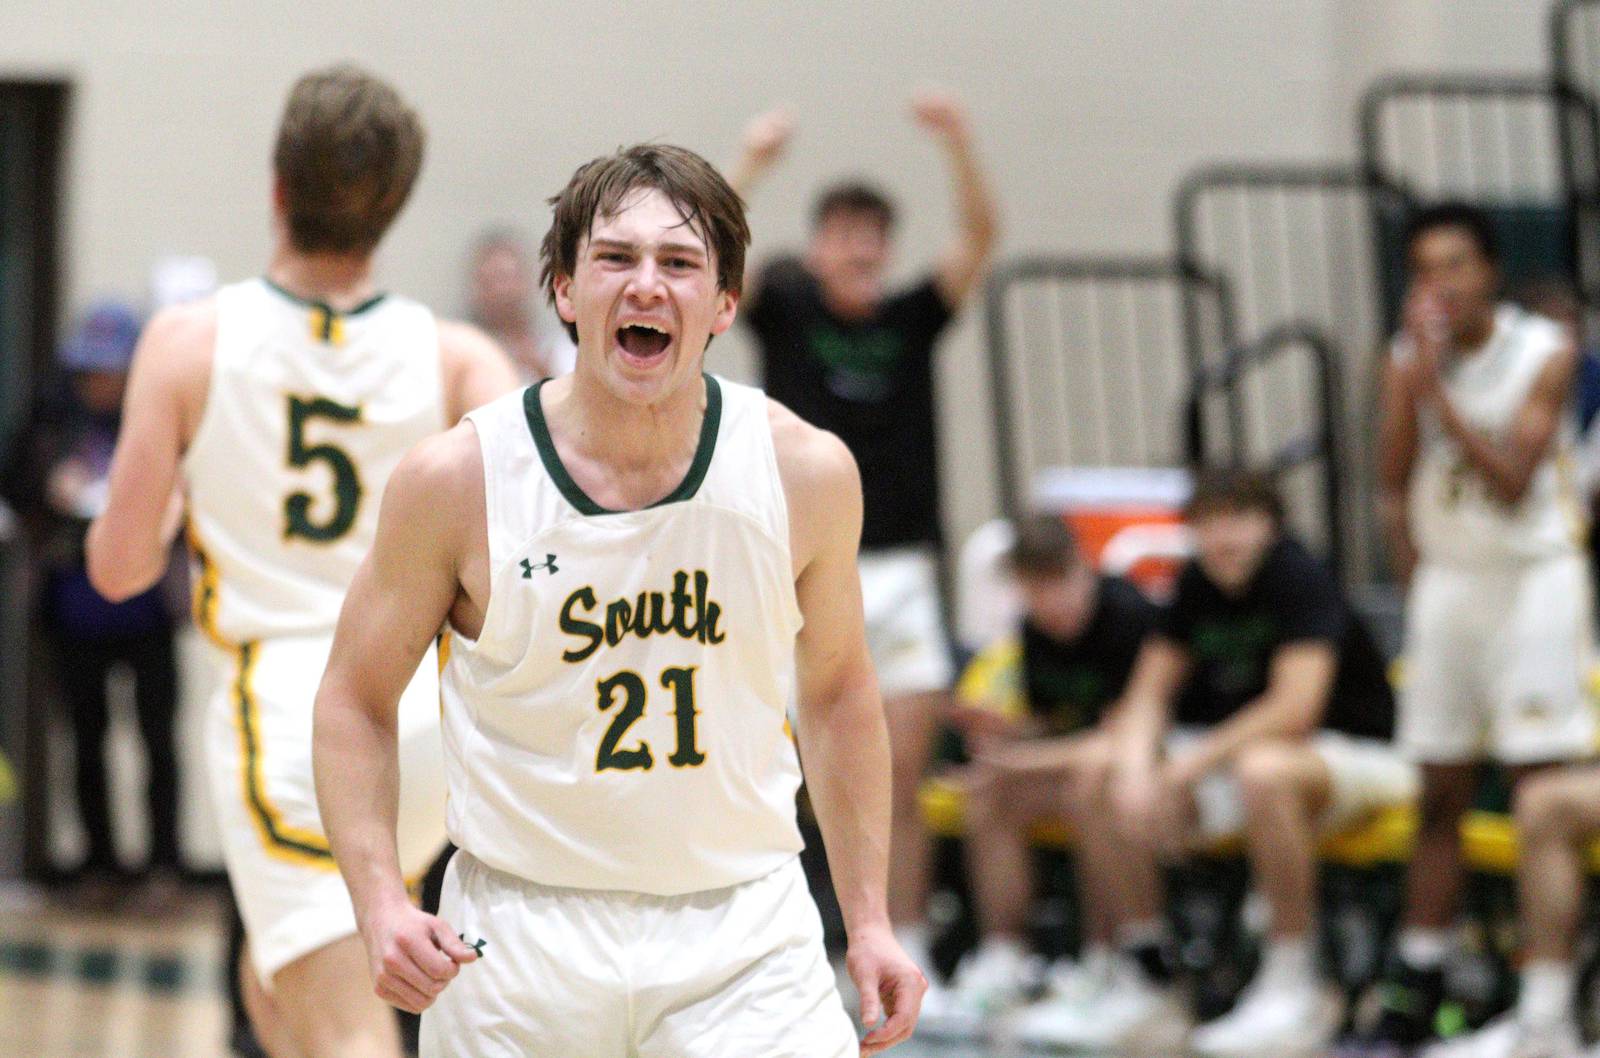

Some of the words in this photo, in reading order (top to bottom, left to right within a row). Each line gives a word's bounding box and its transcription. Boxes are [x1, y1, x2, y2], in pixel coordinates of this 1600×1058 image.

[282, 392, 366, 545] 5
[559, 569, 726, 663] South
[595, 665, 707, 774] 21
